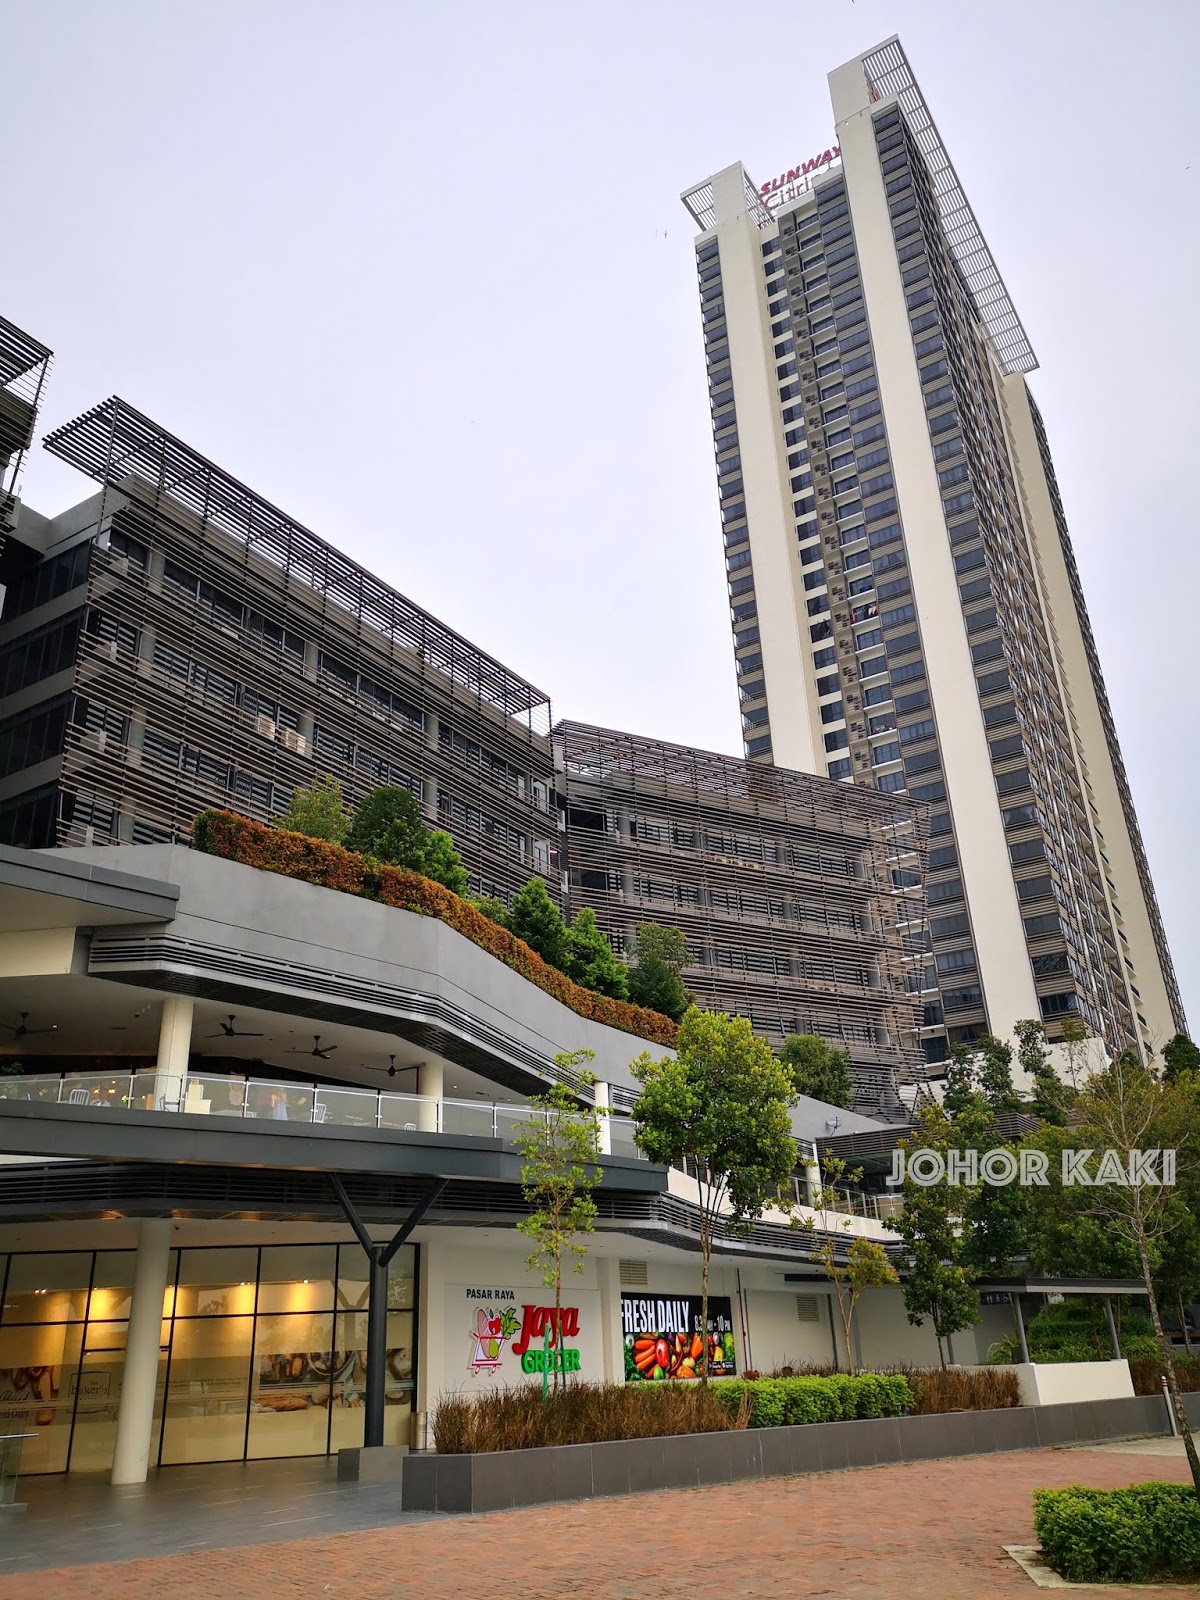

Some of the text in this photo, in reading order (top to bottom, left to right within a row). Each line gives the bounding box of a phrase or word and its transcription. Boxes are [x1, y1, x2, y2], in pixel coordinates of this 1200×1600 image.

[759, 145, 841, 197] SUNWAY
[466, 1288, 515, 1300] PASAR RAYA
[511, 1304, 581, 1355] Jaya
[657, 1300, 689, 1332] DAILY
[717, 1315, 724, 1332] 10
